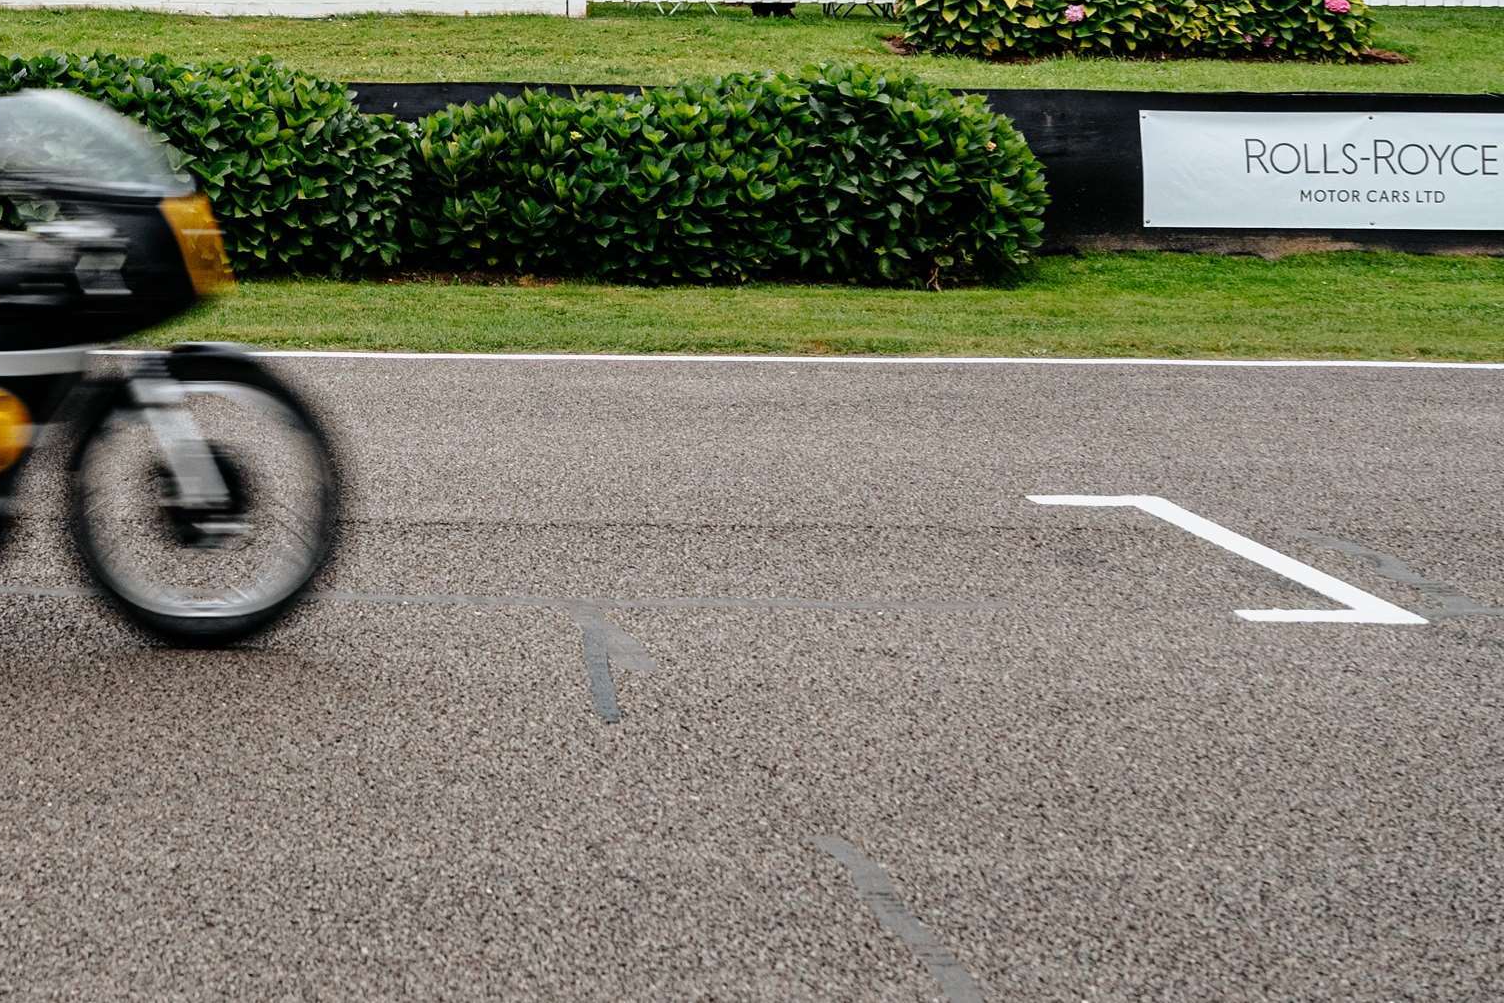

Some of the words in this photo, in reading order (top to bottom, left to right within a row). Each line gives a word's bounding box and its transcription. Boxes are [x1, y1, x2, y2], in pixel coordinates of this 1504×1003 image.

[1245, 138, 1499, 176] ROLLS-ROYCE
[1300, 189, 1361, 203] MOTOR
[1366, 190, 1411, 203] CARS
[1416, 190, 1446, 204] LTD
